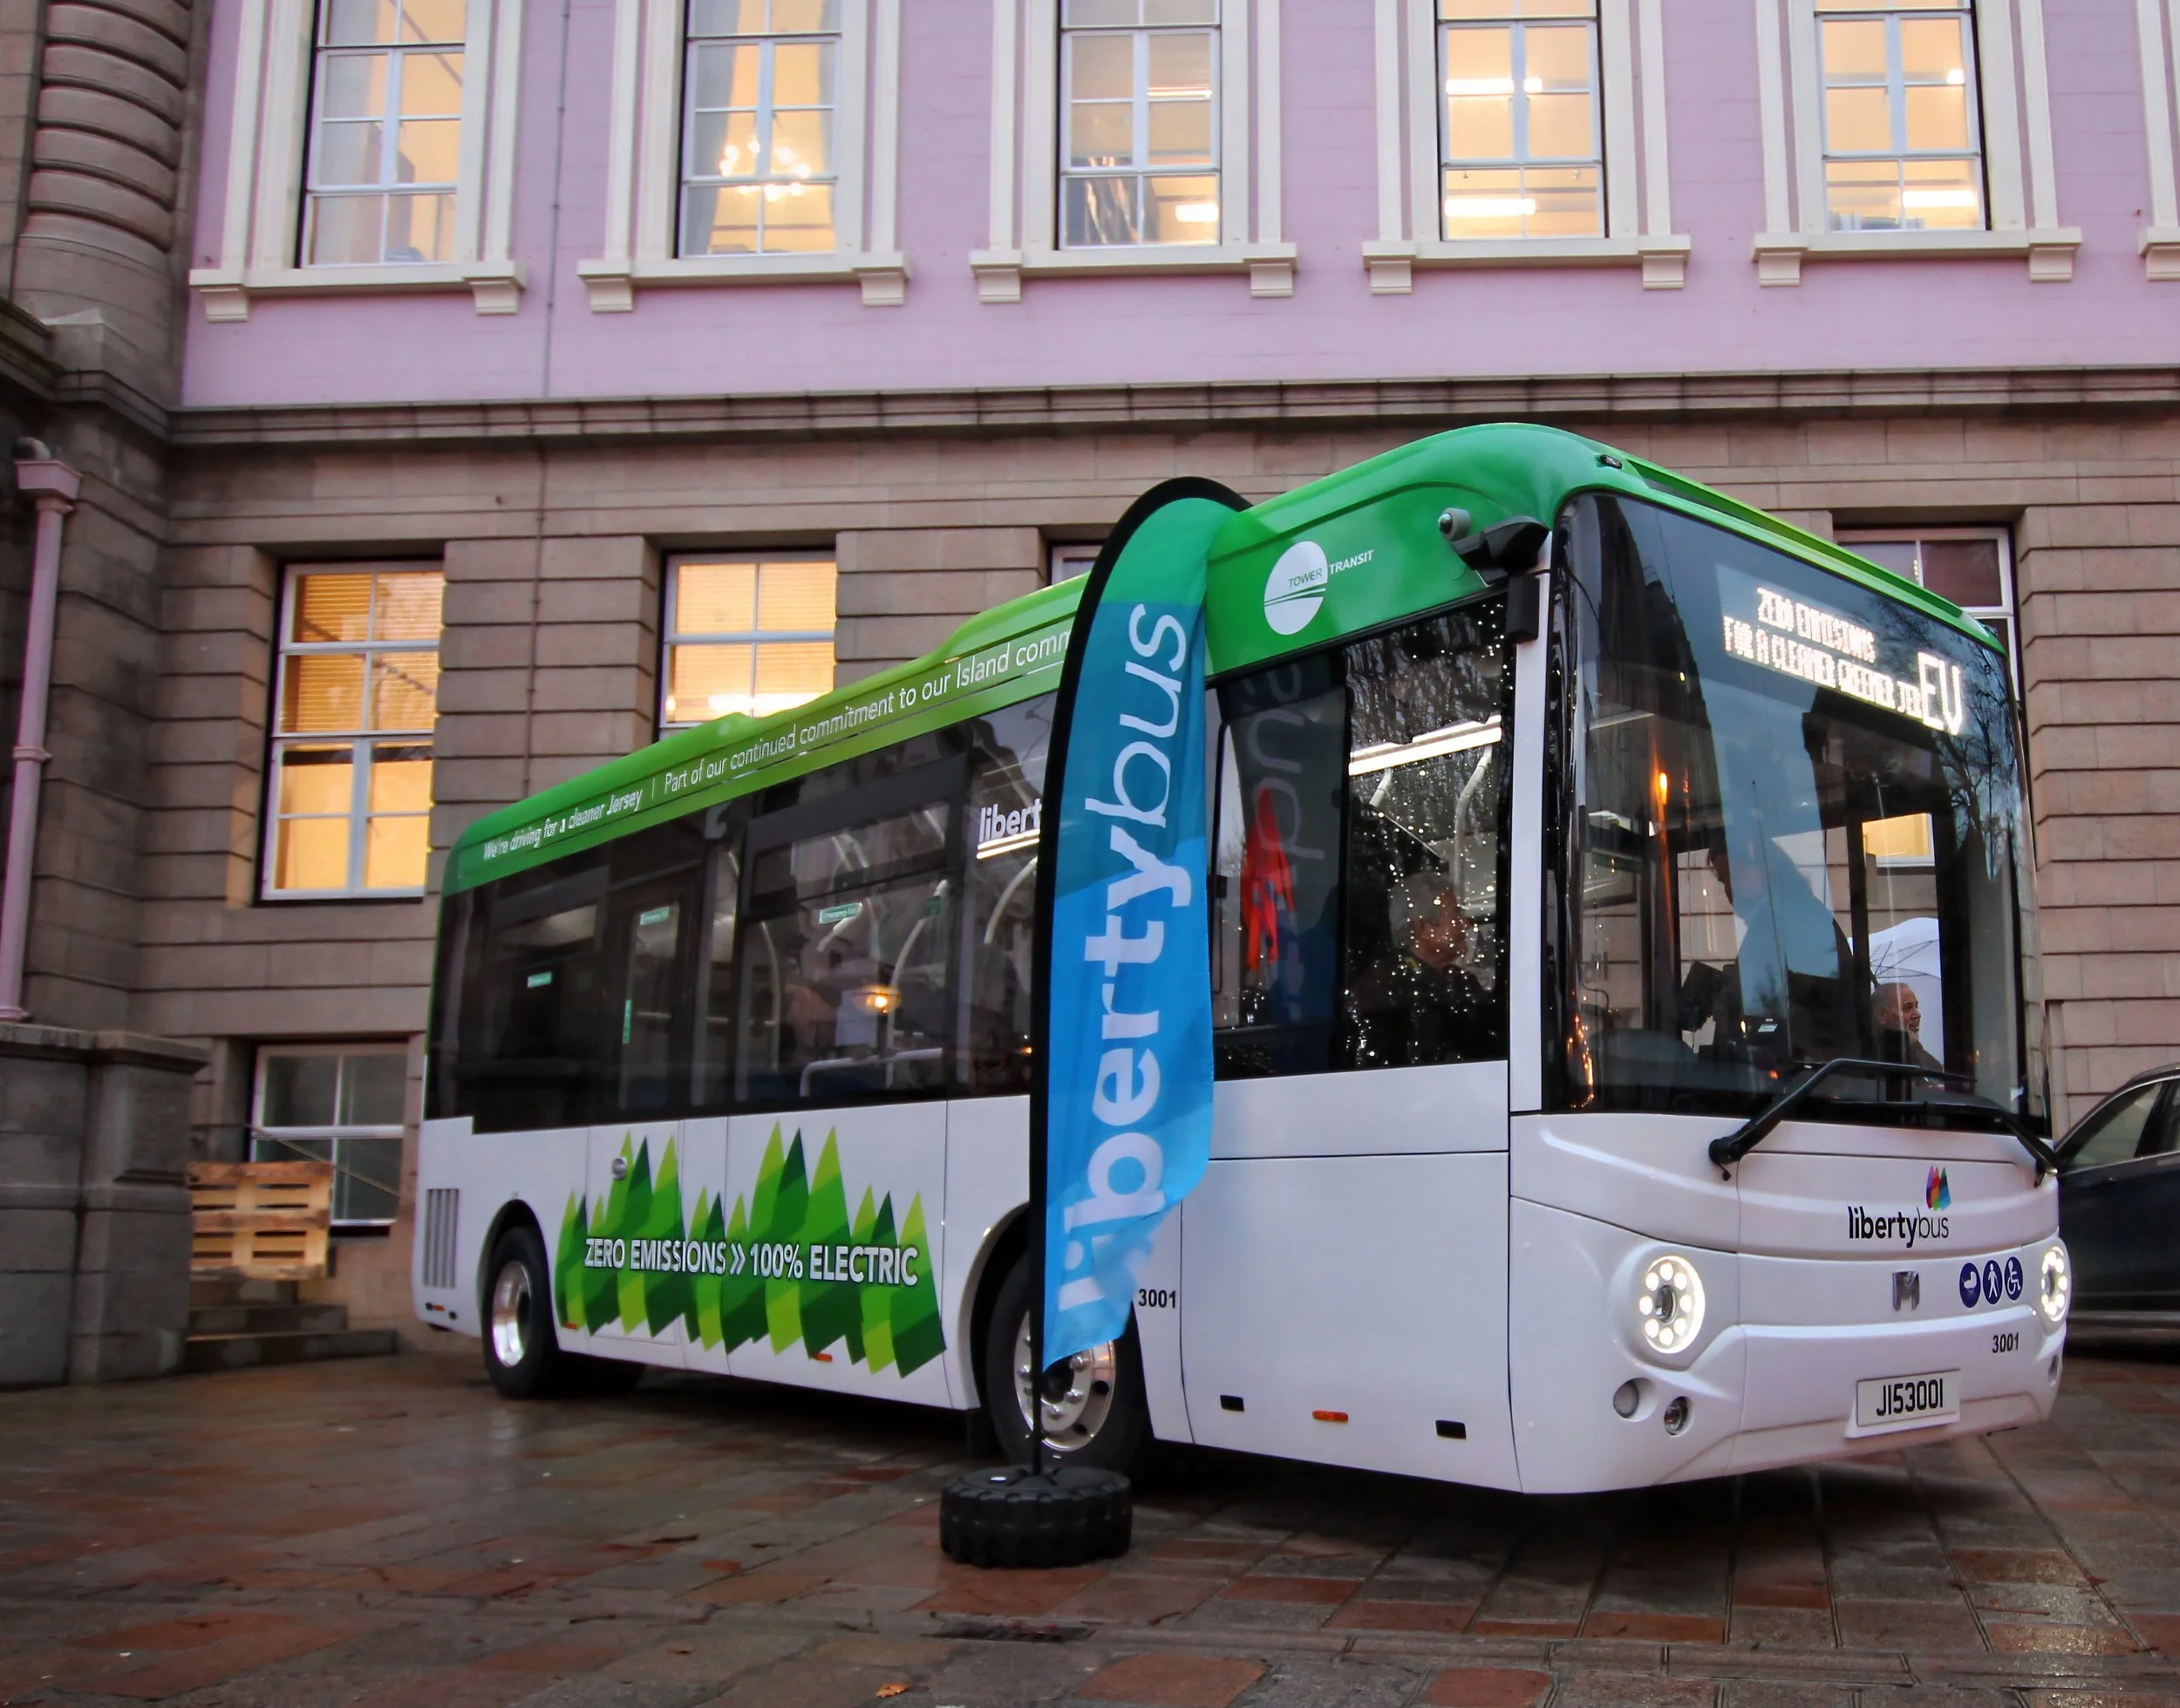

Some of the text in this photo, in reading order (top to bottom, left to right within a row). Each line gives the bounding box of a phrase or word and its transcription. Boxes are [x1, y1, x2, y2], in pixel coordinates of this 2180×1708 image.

[1289, 549, 1374, 588] TOWER TRANSIT
[1918, 651, 1963, 736] EV
[543, 818, 558, 839] for
[606, 789, 644, 816] Jersey
[664, 771, 688, 794] Part
[691, 759, 705, 784] of
[706, 757, 728, 779] our
[730, 723, 796, 771] continued
[800, 696, 894, 745] commitment
[899, 687, 916, 709] to
[922, 673, 951, 701] our
[956, 642, 1011, 689] Island
[1059, 603, 1192, 1311] libertybus
[1848, 1206, 1949, 1249] libertybus
[583, 1238, 918, 1286] ZERO EMISSIONS 100% ELECTRIC
[1138, 1289, 1175, 1309] 3001
[1992, 1332, 2020, 1353] 3001
[1877, 1378, 1943, 1417] J153001
